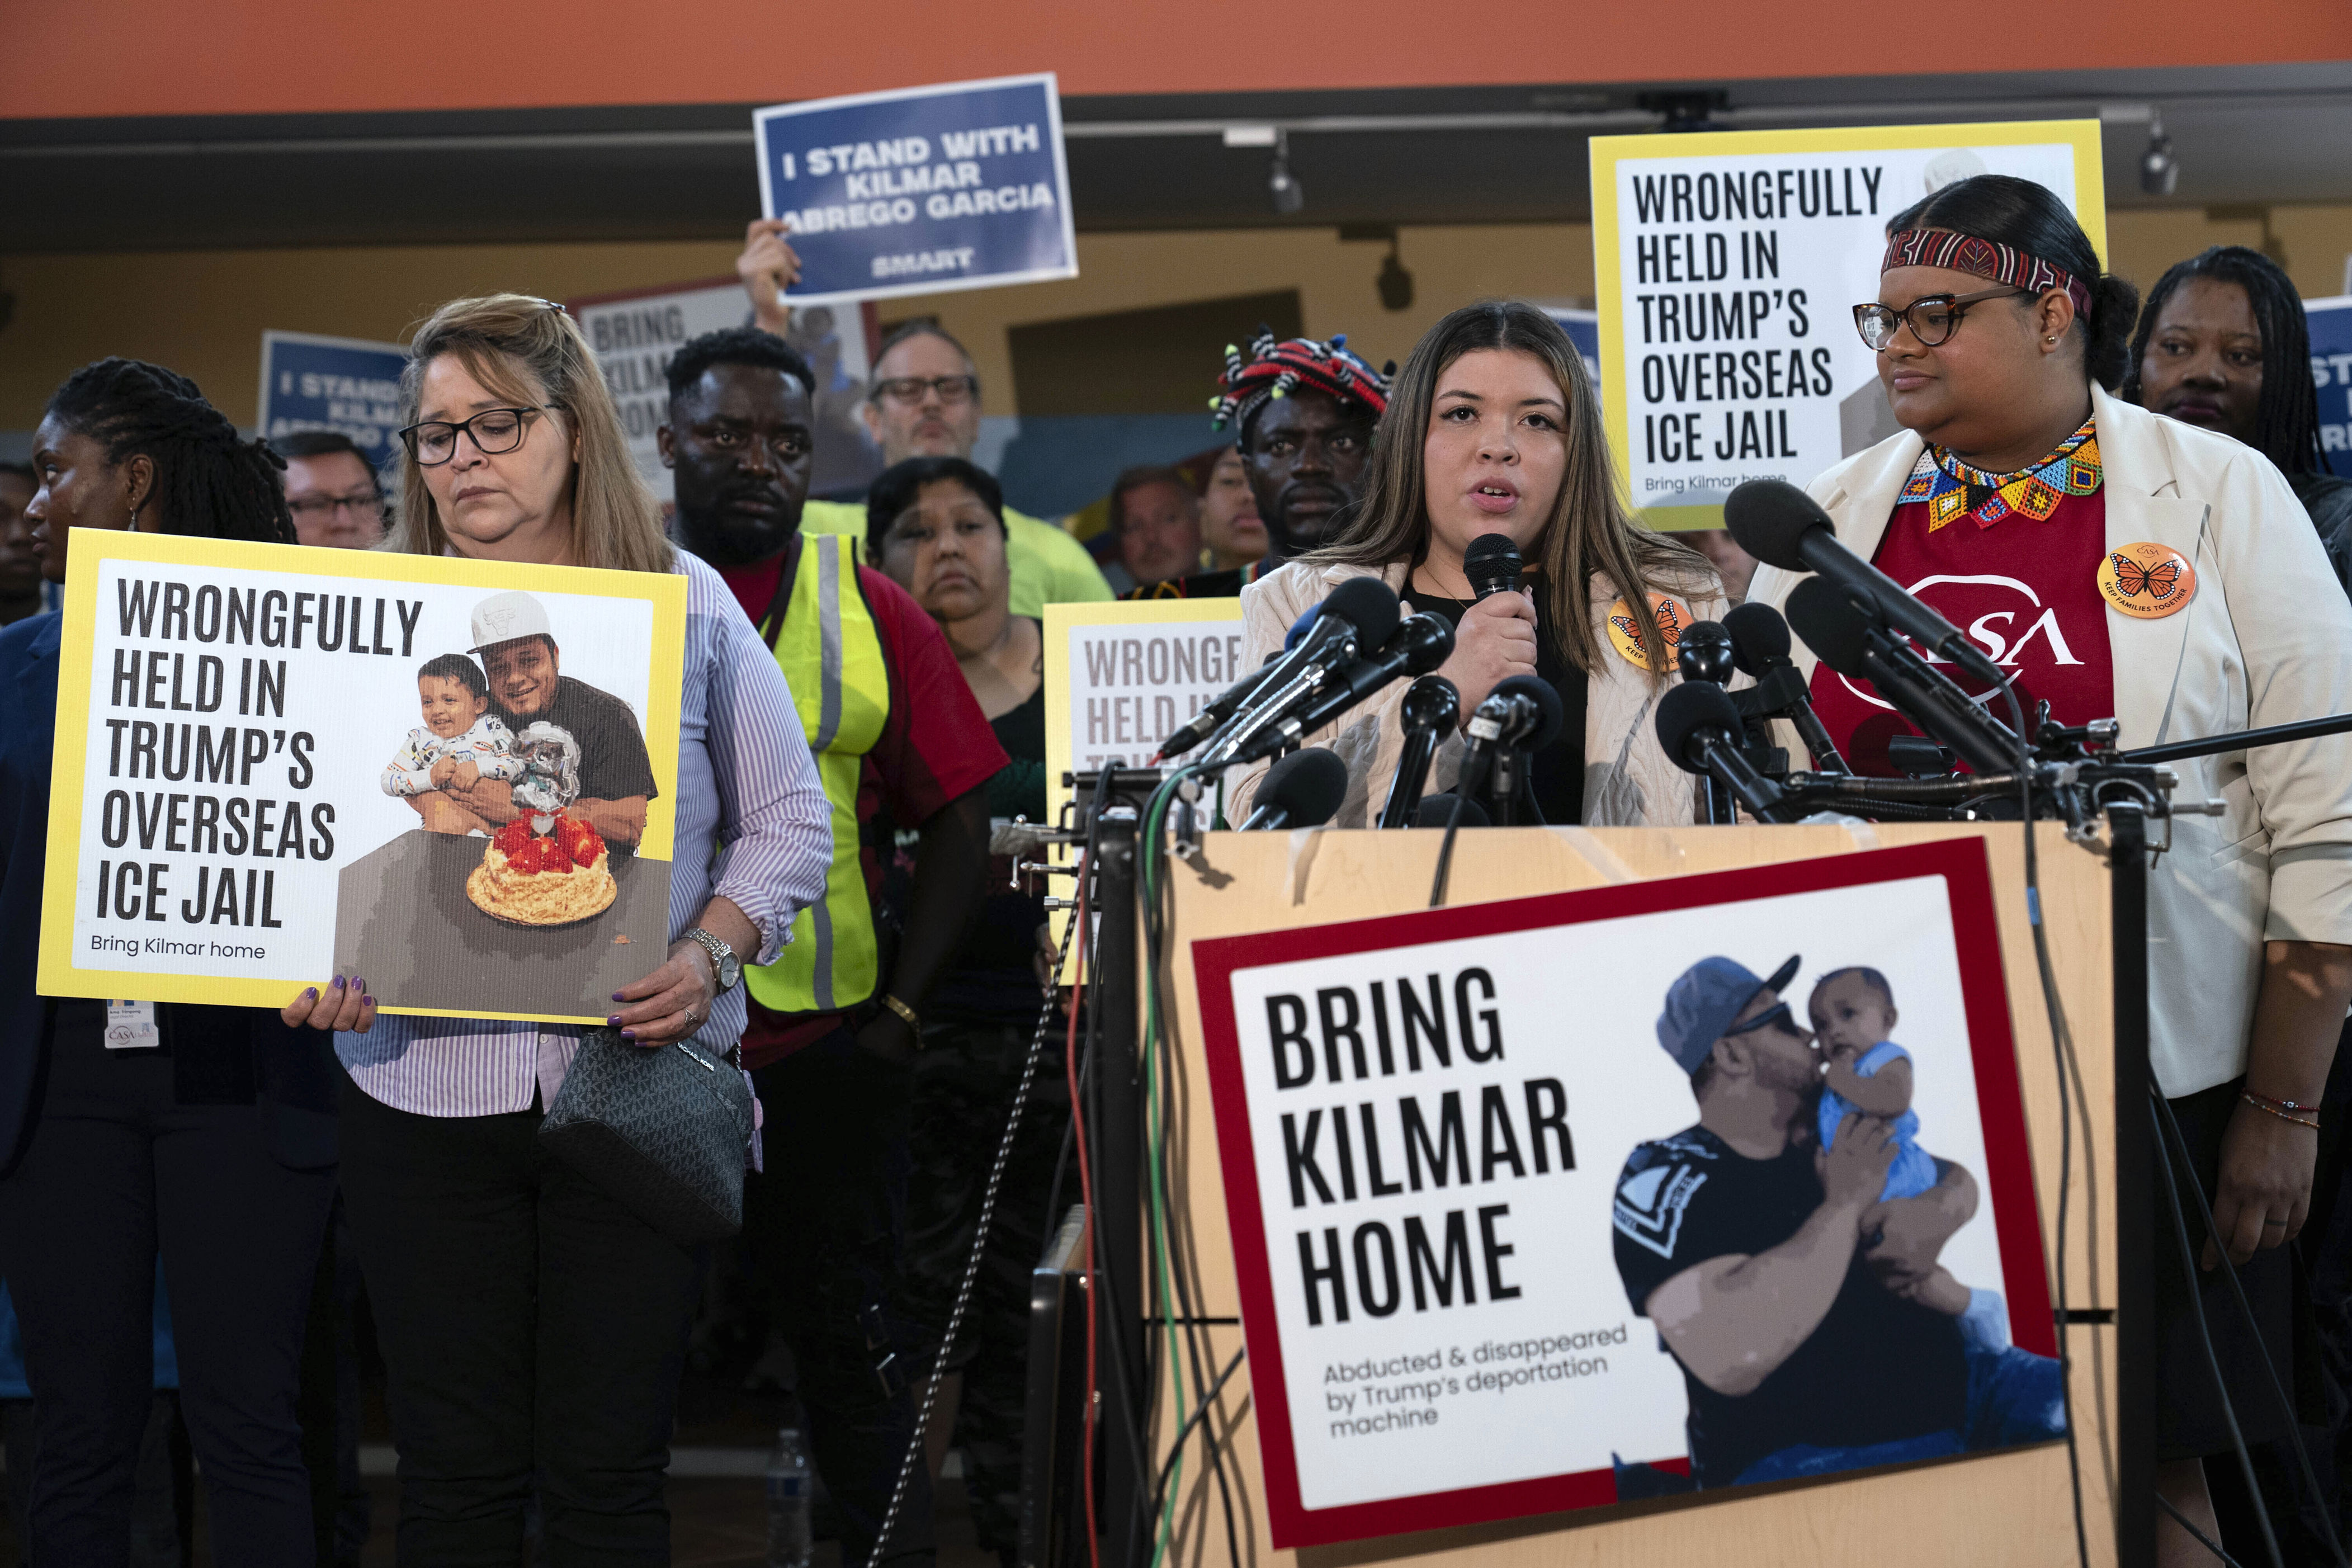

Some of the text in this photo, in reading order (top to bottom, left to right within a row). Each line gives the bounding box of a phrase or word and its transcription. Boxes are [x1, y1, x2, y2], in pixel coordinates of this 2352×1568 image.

[783, 123, 1041, 181] I STAND WITH
[845, 160, 983, 200] KILMAR
[1633, 166, 1883, 224] WRONGFULLY
[783, 182, 1055, 235] ABREGO GARCIA
[872, 247, 975, 278] SMART
[1637, 230, 1779, 284] HELD IN
[593, 306, 684, 352] BRING
[1637, 289, 1809, 344] TRUMP'S
[1642, 347, 1834, 404] OVERSEAS
[1646, 409, 1798, 463] ICE JAIL
[1646, 476, 1684, 494] Bring
[1689, 475, 1737, 490] Kilmar
[117, 578, 423, 657] WRONGFULLY
[2104, 581, 2188, 612] KEEP FAMILIES TOGETHER
[1625, 645, 1644, 660] KEEP
[111, 649, 287, 718] HELD IN
[1087, 695, 1175, 745] HELD
[106, 719, 315, 790] TRUMP'S
[101, 789, 336, 861] OVERSEAS
[96, 860, 282, 928] ICE JAIL
[91, 935, 266, 959] Bring Kilmar home
[1264, 966, 1504, 1091] BRING
[677, 1042, 715, 1071] MICHAEL KORS
[1280, 1078, 1577, 1209] KILMAR
[1296, 1203, 1522, 1328] HOME
[1324, 1324, 1628, 1386] Abducted & disappeared
[1326, 1356, 1608, 1415] by Trump's deportation
[1330, 1406, 1439, 1439] machine
